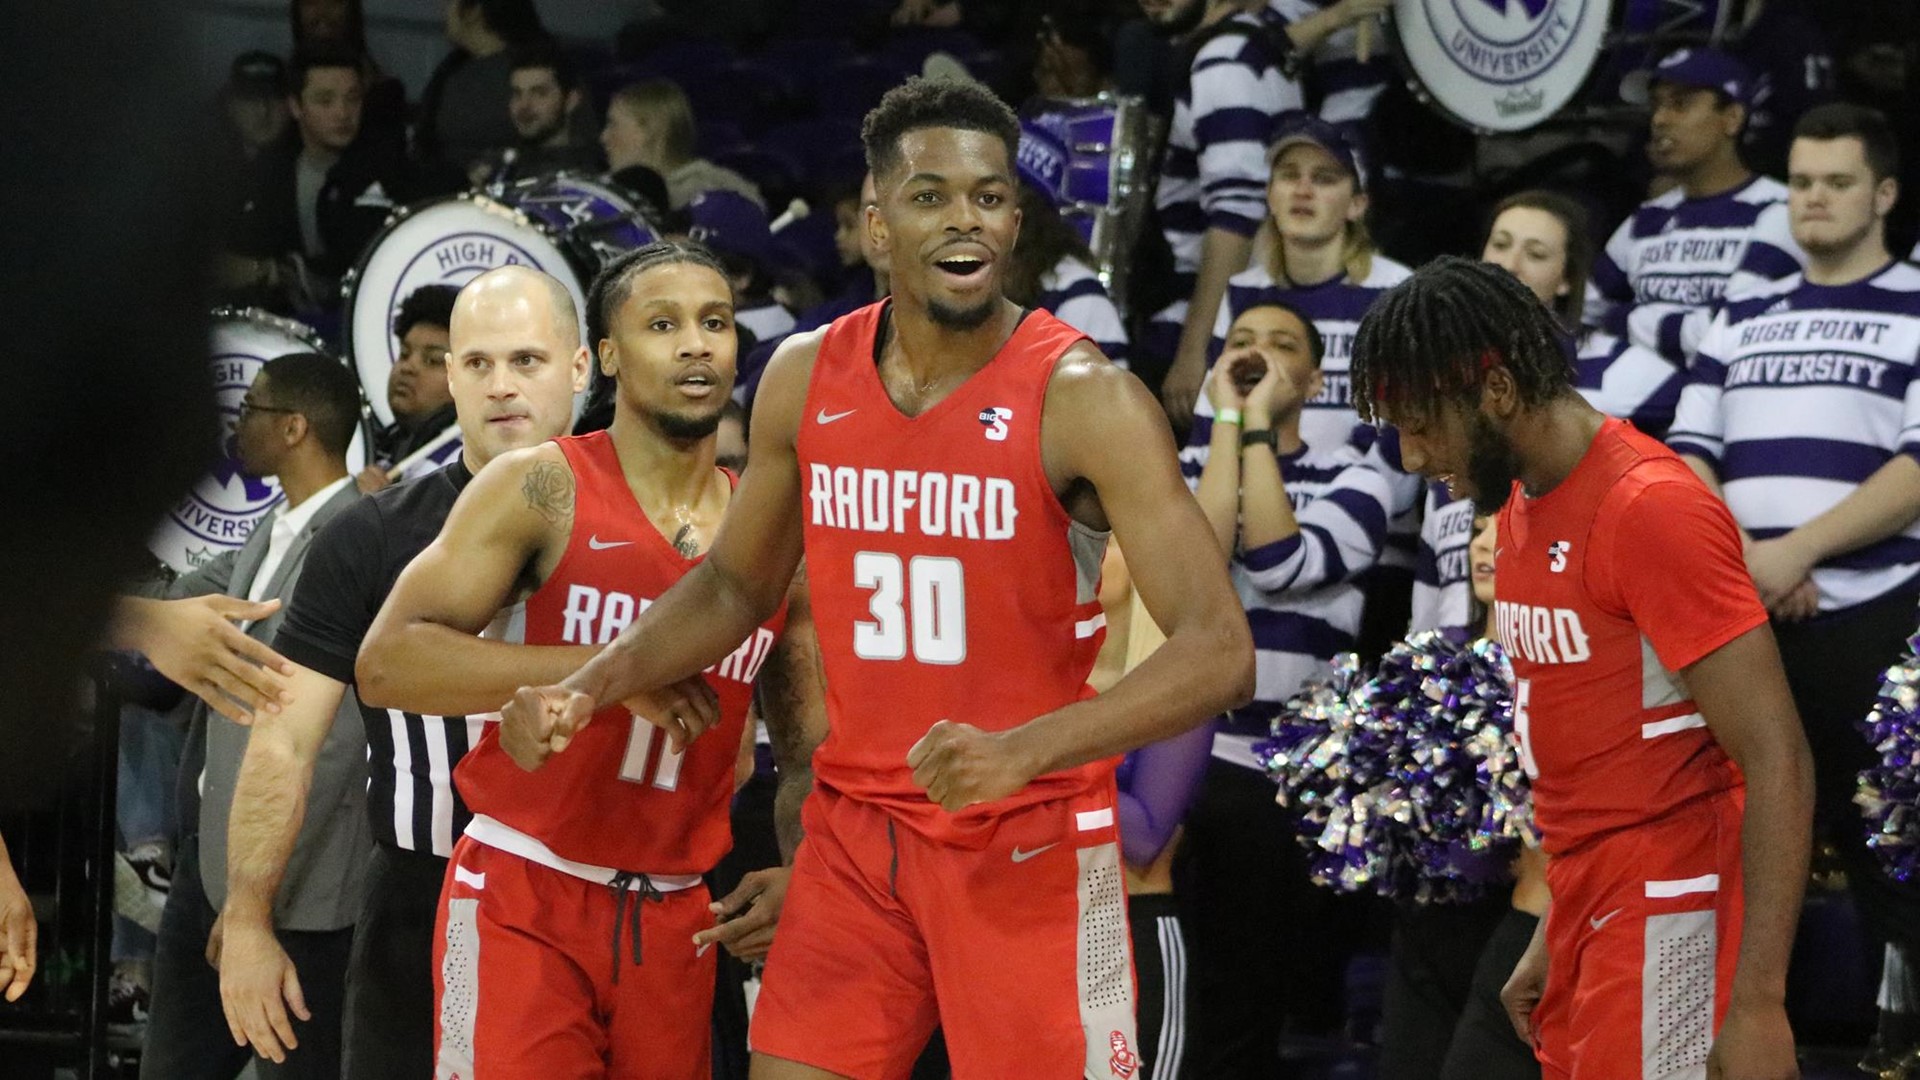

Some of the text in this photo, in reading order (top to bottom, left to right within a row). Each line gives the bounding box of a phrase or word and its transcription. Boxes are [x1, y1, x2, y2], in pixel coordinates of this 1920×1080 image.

[1451, 11, 1568, 75] UNIVERSITY
[436, 241, 495, 270] HIGH
[1681, 239, 1741, 262] POINT
[1740, 320, 1890, 347] HIGH POINT
[809, 463, 1019, 541] RADFORD
[1439, 510, 1471, 540] HIG
[854, 550, 967, 665] 30
[1494, 599, 1591, 664] DFORD
